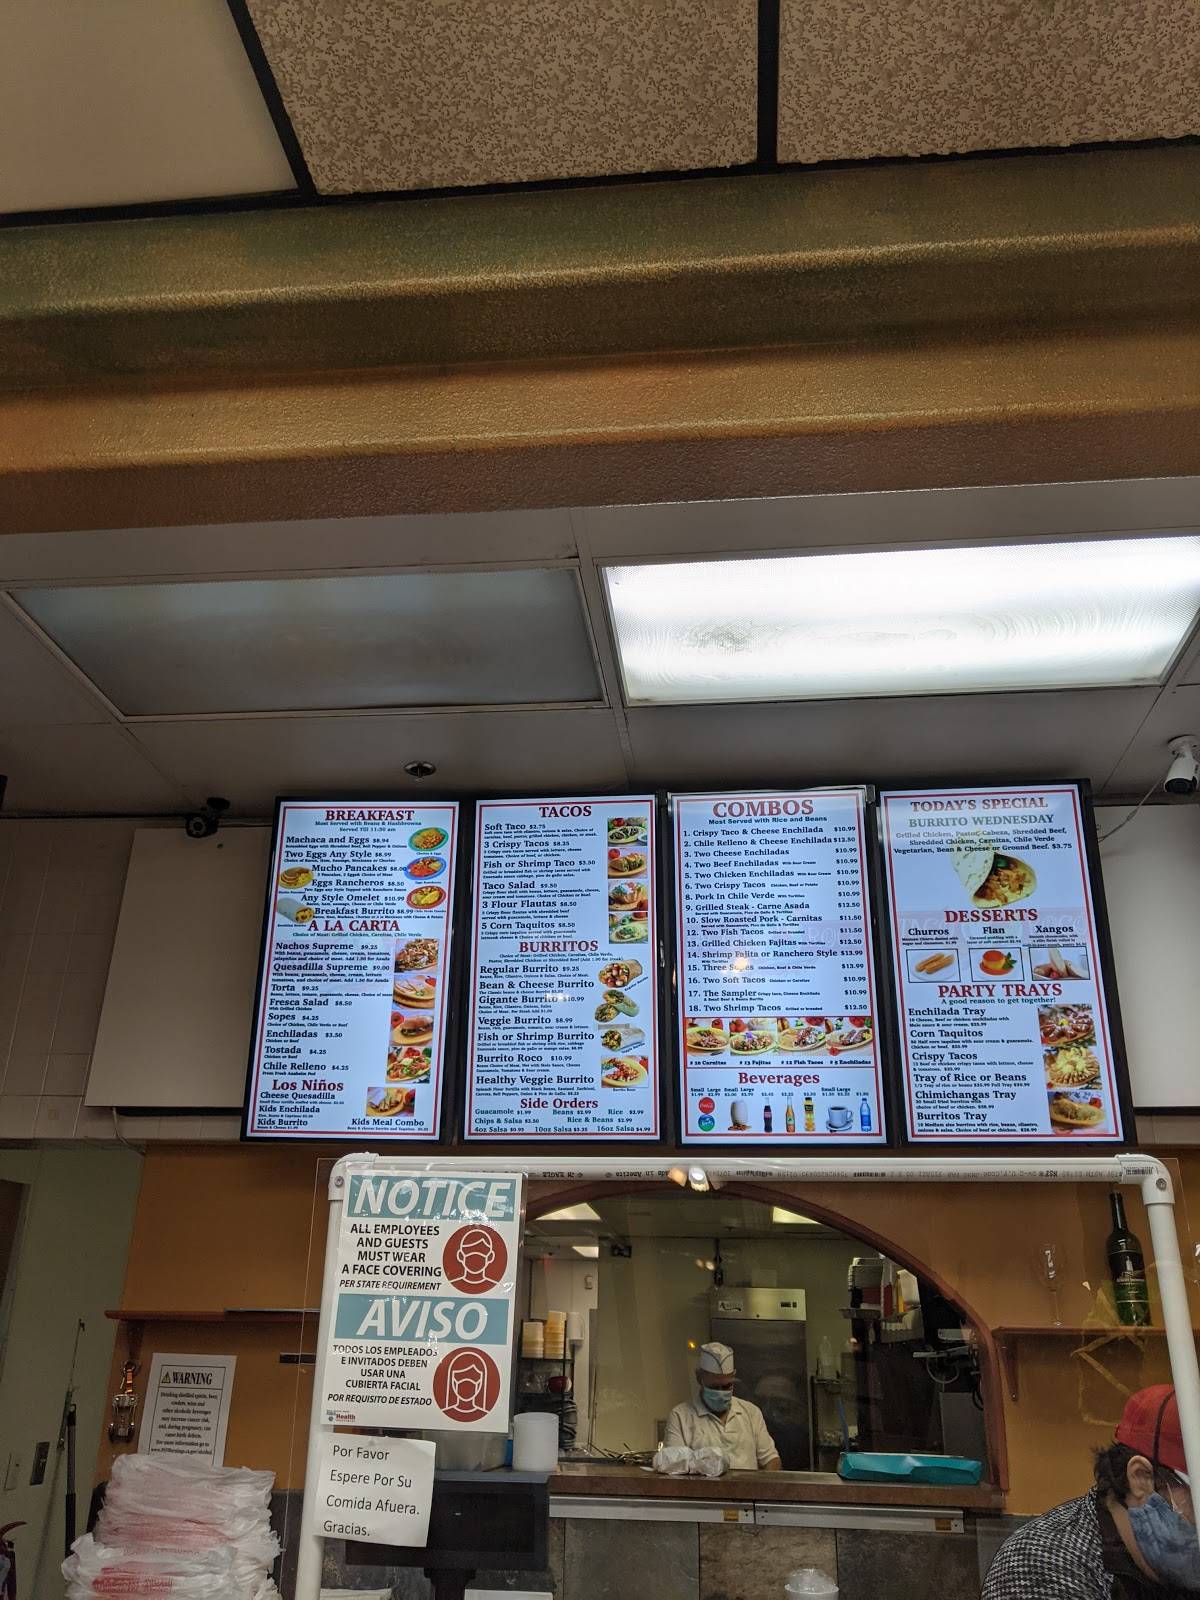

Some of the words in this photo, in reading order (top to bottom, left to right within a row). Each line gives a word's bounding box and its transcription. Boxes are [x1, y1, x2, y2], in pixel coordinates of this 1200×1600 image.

[713, 800, 814, 818] COMBOS
[911, 800, 976, 812] TODAY'S
[982, 797, 1048, 810] SPECIAL
[325, 810, 415, 821] BREAKFAST
[539, 806, 591, 817] TACOS
[909, 817, 968, 828] BURRITO
[973, 815, 1054, 825] WEDNESDAY
[693, 829, 718, 837] Crispy
[782, 826, 823, 834] Enchilada
[306, 851, 326, 859] Eggs
[330, 851, 346, 859] Any
[350, 850, 372, 858] Style
[518, 860, 551, 868] Shrimp
[312, 879, 332, 887] Eggs
[508, 881, 535, 889] Salad
[301, 895, 318, 903] Any
[322, 894, 343, 902] Style
[945, 909, 1038, 923] DESSERTS
[308, 921, 318, 931] A
[324, 921, 344, 931] LA
[349, 921, 400, 931] CARTA
[982, 926, 1005, 934] Flan
[1036, 925, 1074, 934] Xangos
[908, 928, 949, 936] Churros
[313, 943, 353, 951] Supreme
[519, 941, 598, 952] BURRITOS
[274, 964, 323, 972] Quesadilla
[326, 964, 368, 972] Supreme
[480, 966, 519, 974] Regular
[558, 980, 594, 988] Burrito
[722, 990, 756, 998] Sampler
[938, 985, 997, 997] PARTY
[1002, 984, 1062, 996] TRAYS
[908, 1008, 959, 1016] Enchilada
[963, 1007, 986, 1017] Tray
[478, 1017, 511, 1026] Veggie
[514, 1016, 551, 1024] Burrito
[476, 1076, 516, 1085] Healthy
[519, 1076, 553, 1085] Veggie
[738, 1072, 820, 1086] Beverages
[914, 1074, 936, 1082] Tray
[272, 1080, 296, 1091] Los
[302, 1079, 344, 1091] Niños
[520, 1098, 548, 1108] Side
[553, 1098, 598, 1108] Orders
[354, 1179, 511, 1218] NOTICE
[350, 1224, 371, 1234] ALL
[374, 1225, 440, 1236] EMPLOYEES
[357, 1238, 382, 1248] AND
[385, 1238, 428, 1249] GUESTS
[358, 1251, 390, 1261] MUST
[392, 1252, 426, 1263] WEAR
[342, 1265, 350, 1274] A
[353, 1265, 379, 1275] FACE
[383, 1266, 442, 1277] COVERING
[356, 1280, 381, 1289] STATE
[382, 1281, 441, 1290] REQUIREMENT
[356, 1300, 489, 1340] AVISO
[333, 1344, 363, 1354] TODOS
[366, 1346, 382, 1355] LOS
[349, 1357, 395, 1367] INVITADOS
[398, 1358, 427, 1367] DEBEN
[172, 1372, 212, 1385] WARNING
[360, 1368, 384, 1377] USAR
[387, 1370, 405, 1378] UNA
[346, 1380, 388, 1389] CUBIERTA
[390, 1381, 421, 1391] FACIAL
[328, 1393, 344, 1401] POR
[346, 1394, 387, 1404] REQUISITO
[389, 1396, 400, 1404] DE
[401, 1396, 432, 1406] ESTADO
[333, 1445, 352, 1456] Por
[357, 1447, 390, 1460] Favor
[330, 1470, 370, 1484] Espere
[374, 1474, 394, 1486] Por
[398, 1476, 412, 1488] Su
[326, 1494, 372, 1510] Comida
[376, 1499, 420, 1514] Afuera.
[324, 1520, 370, 1536] Gracias.
